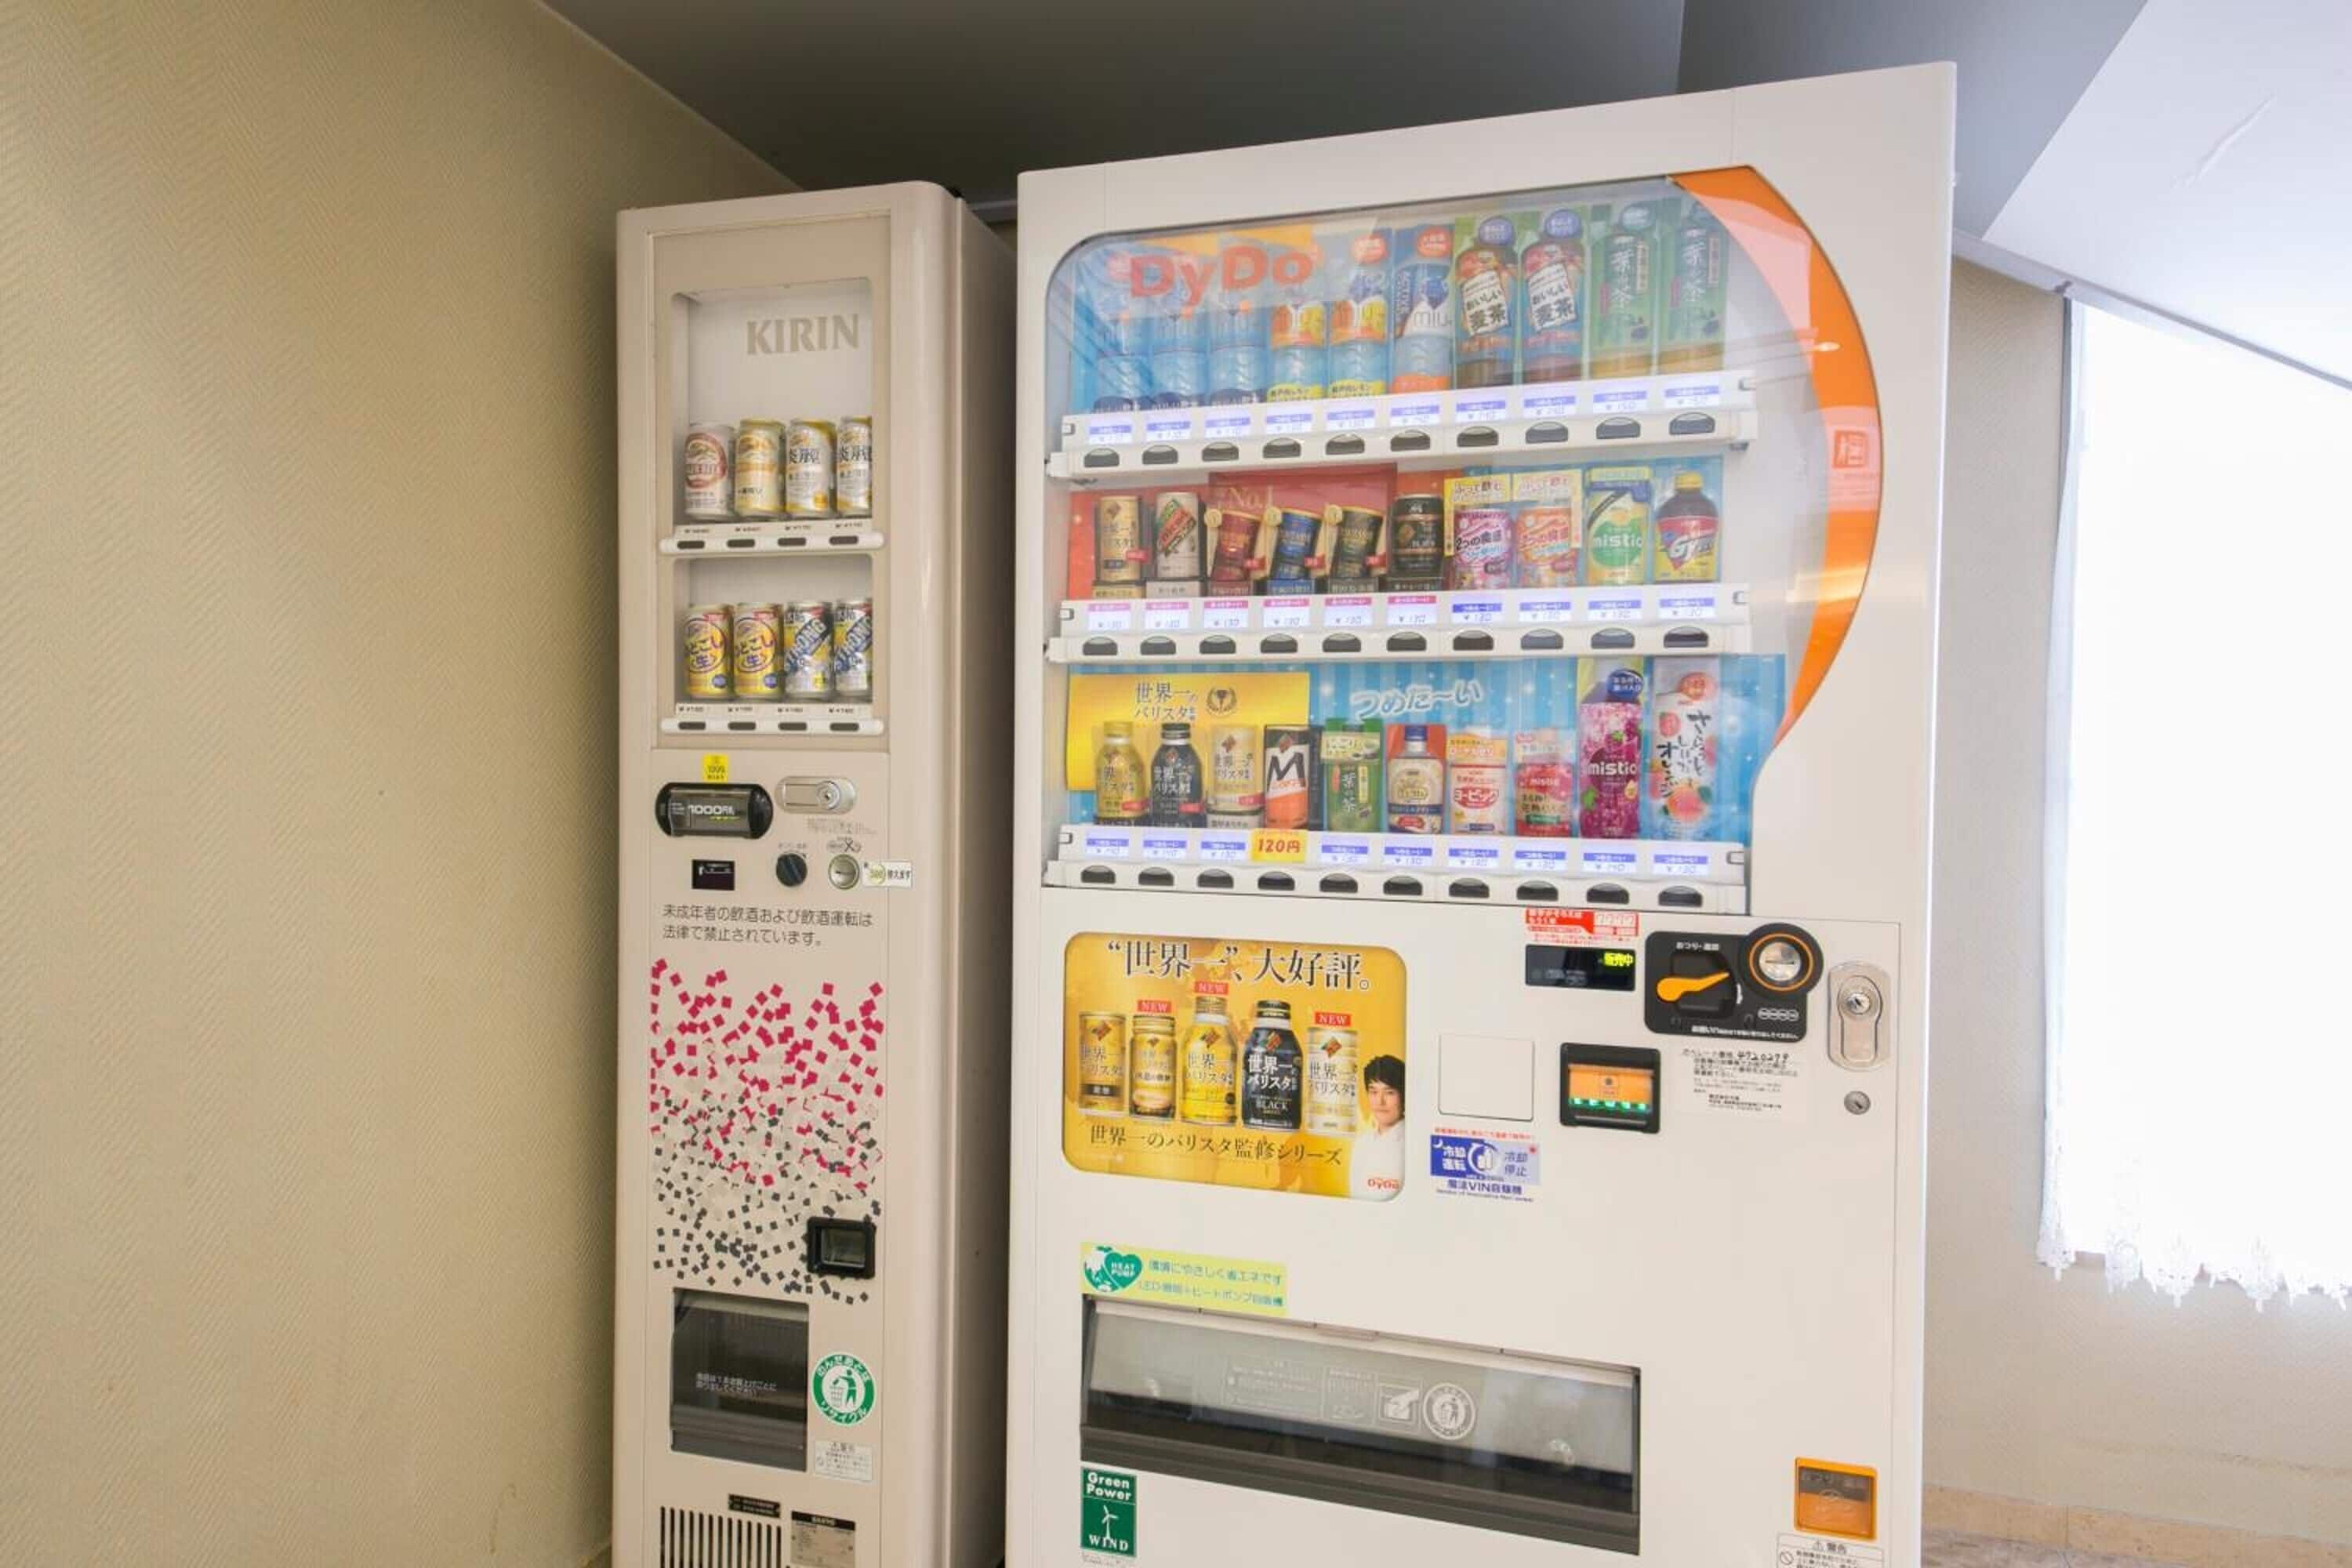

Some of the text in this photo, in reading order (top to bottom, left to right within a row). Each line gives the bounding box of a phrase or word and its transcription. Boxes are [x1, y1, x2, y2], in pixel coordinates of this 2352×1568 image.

[1130, 245, 1313, 307] DyDo
[747, 314, 859, 355] KIRIN
[1589, 760, 1637, 775] mistio
[1258, 838, 1301, 854] 120円
[662, 904, 874, 927] 未成年者の飲酒および飲酒運転は
[662, 924, 822, 946] 法律で禁止されています。
[1199, 982, 1225, 993] NEW
[1142, 1002, 1167, 1012] NEW
[1320, 1014, 1347, 1025] NEW
[1255, 1098, 1287, 1111] BLACK
[1091, 1124, 1342, 1166] 世界一のバリスタ監修シリーズ
[1087, 1472, 1130, 1489] Green
[1087, 1483, 1131, 1501] Power
[1089, 1534, 1129, 1552] WIND
